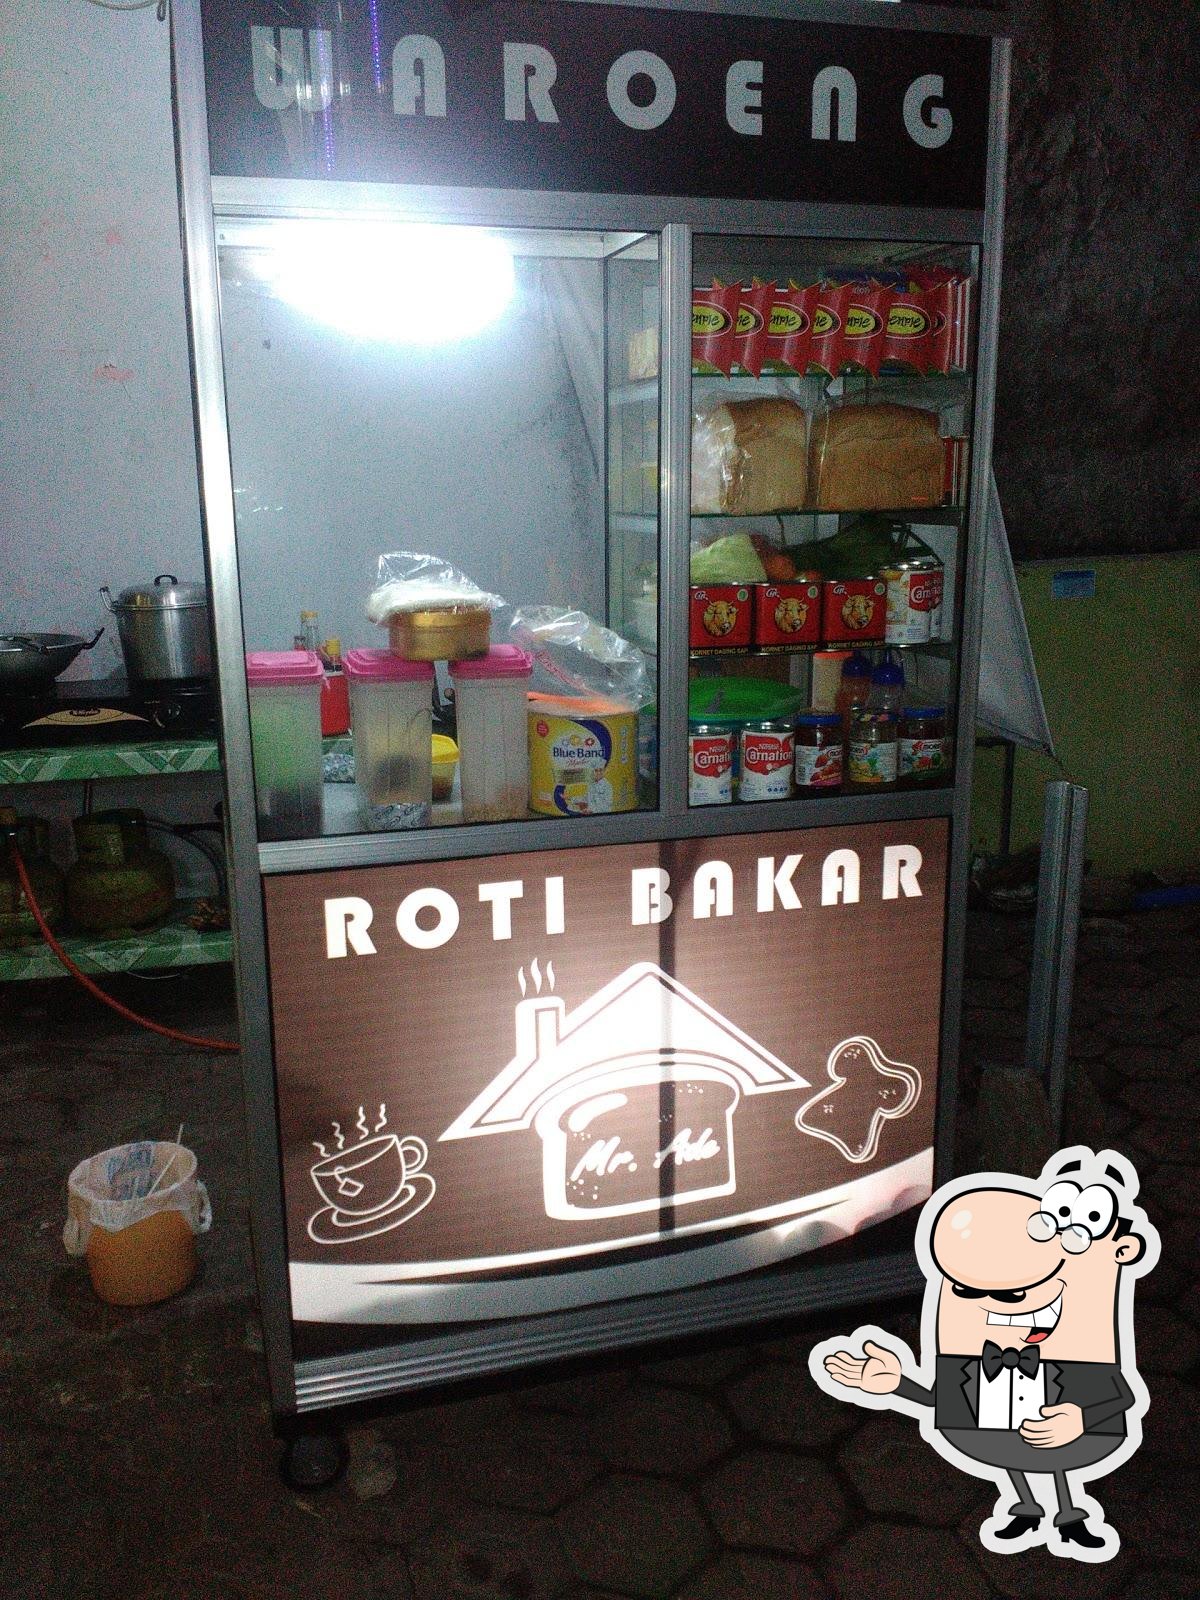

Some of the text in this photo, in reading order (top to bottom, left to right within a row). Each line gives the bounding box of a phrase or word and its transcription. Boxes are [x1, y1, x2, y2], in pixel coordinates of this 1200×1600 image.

[250, 25, 954, 149] WAROENG
[553, 746, 606, 758] Blue Band
[746, 746, 794, 765] Carnation
[324, 844, 924, 959] ROTI BAKAR
[570, 1136, 638, 1181] Mr.
